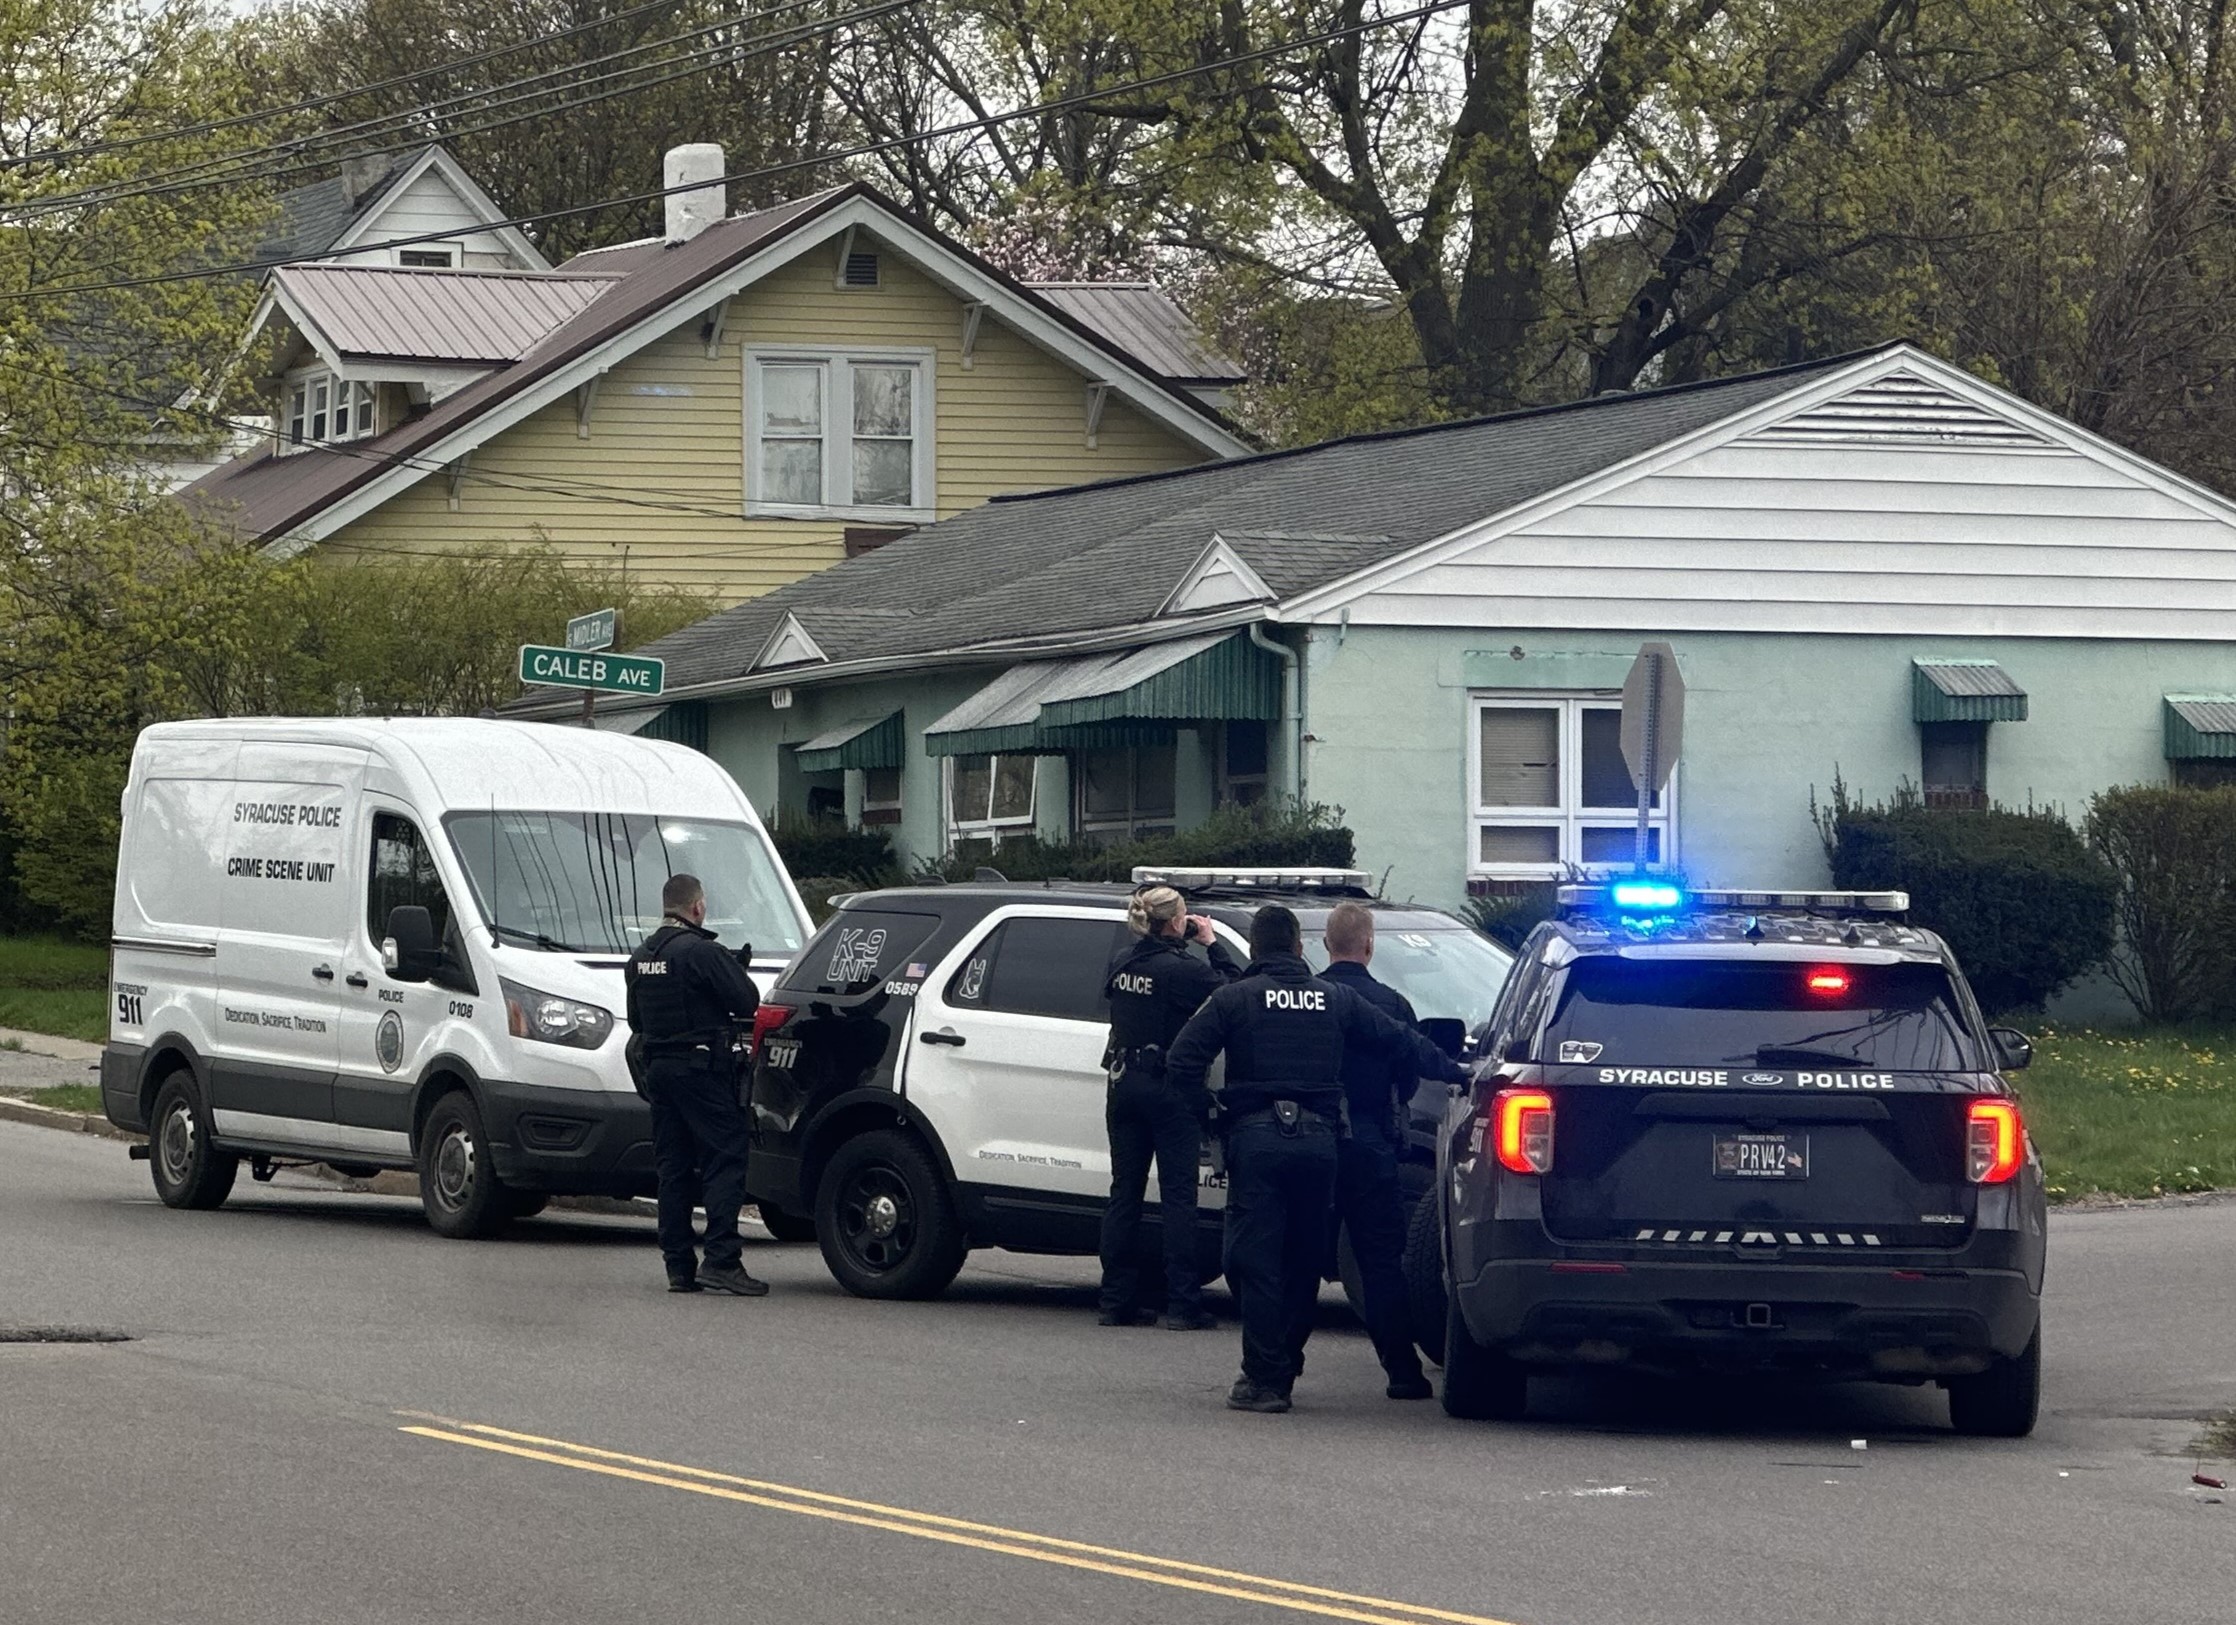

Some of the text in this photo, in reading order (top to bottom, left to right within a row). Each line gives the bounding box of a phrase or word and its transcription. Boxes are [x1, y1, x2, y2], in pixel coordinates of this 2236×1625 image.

[534, 654, 651, 686] CALEB AVE
[234, 802, 341, 827] SYRACUSE POLICE
[228, 857, 335, 882] CRIME SCENE UNIT
[833, 928, 887, 960] K-9
[1397, 934, 1432, 948] K9
[637, 961, 668, 975] POLICE
[826, 958, 878, 982] UNIT
[885, 981, 919, 996] 0589
[1112, 973, 1153, 995] POLICE
[378, 989, 404, 1003] POLICE
[1265, 990, 1326, 1010] POLICE
[118, 994, 143, 1025] 911
[449, 1001, 473, 1018] 0108
[768, 1046, 798, 1069] 911
[1599, 1069, 1728, 1086] SYRACUSE
[1797, 1072, 1895, 1089] POLICE
[1740, 1144, 1786, 1169] PRV42
